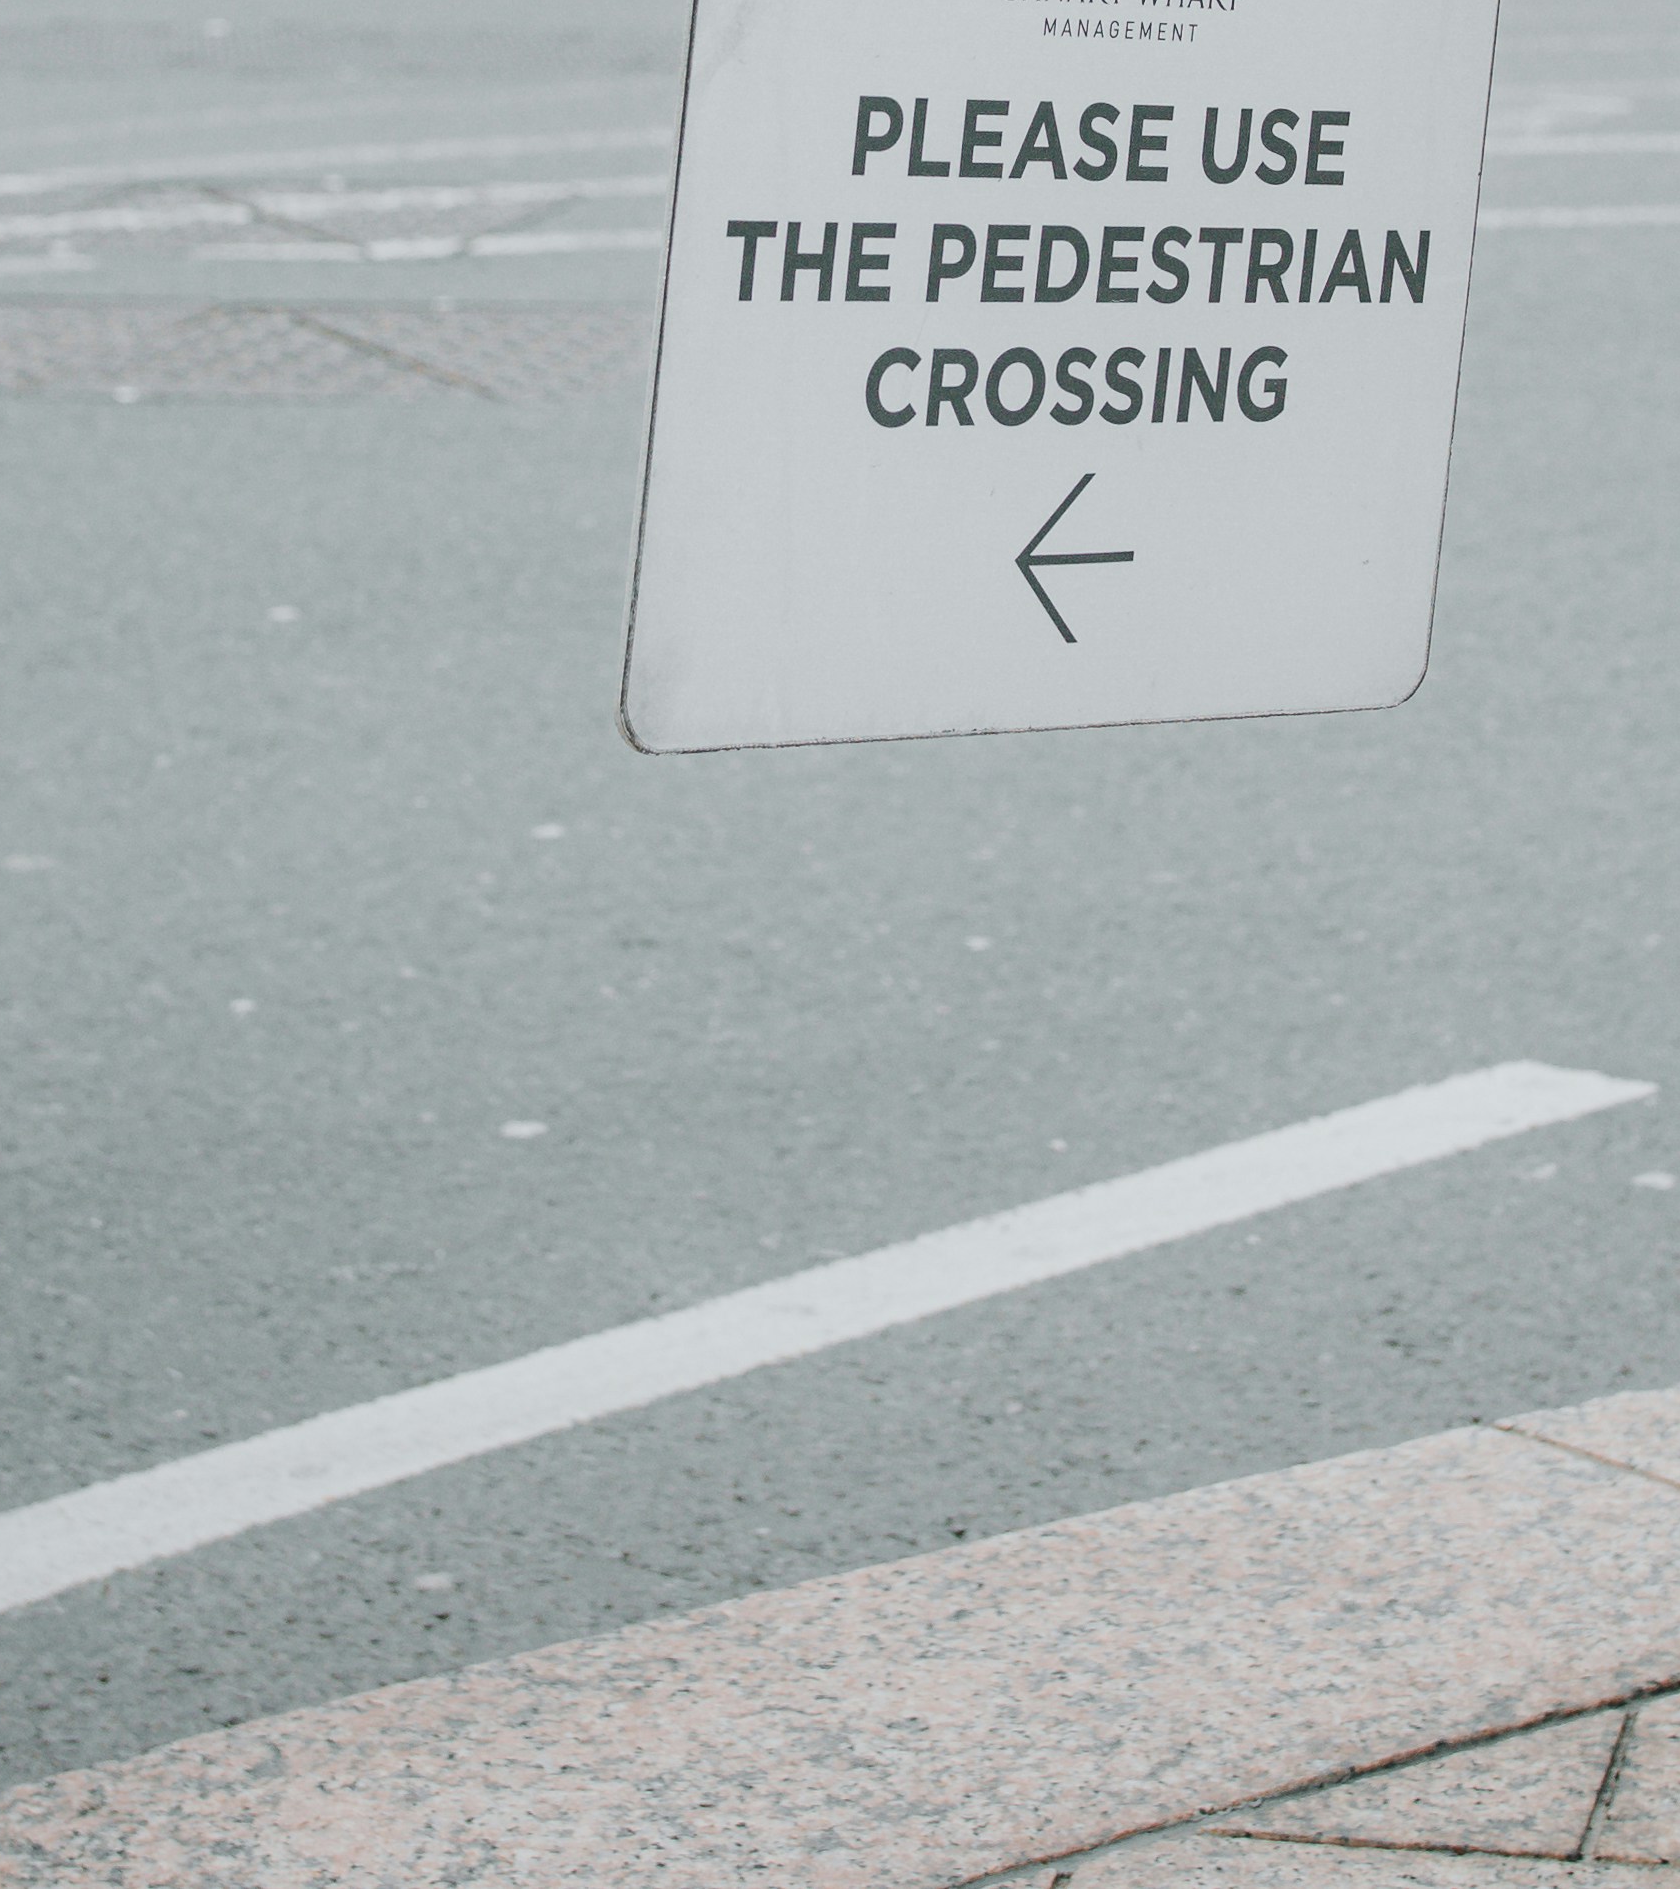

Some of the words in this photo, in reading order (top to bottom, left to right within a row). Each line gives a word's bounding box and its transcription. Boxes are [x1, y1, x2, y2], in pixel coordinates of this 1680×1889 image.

[1043, 17, 1199, 43] MANAGEMENT
[851, 95, 1175, 182] PLEASE
[1201, 106, 1351, 186] USE
[725, 219, 898, 303] THE
[925, 222, 1432, 304] PEDESTRIAN
[864, 345, 1289, 428] CROSSING
